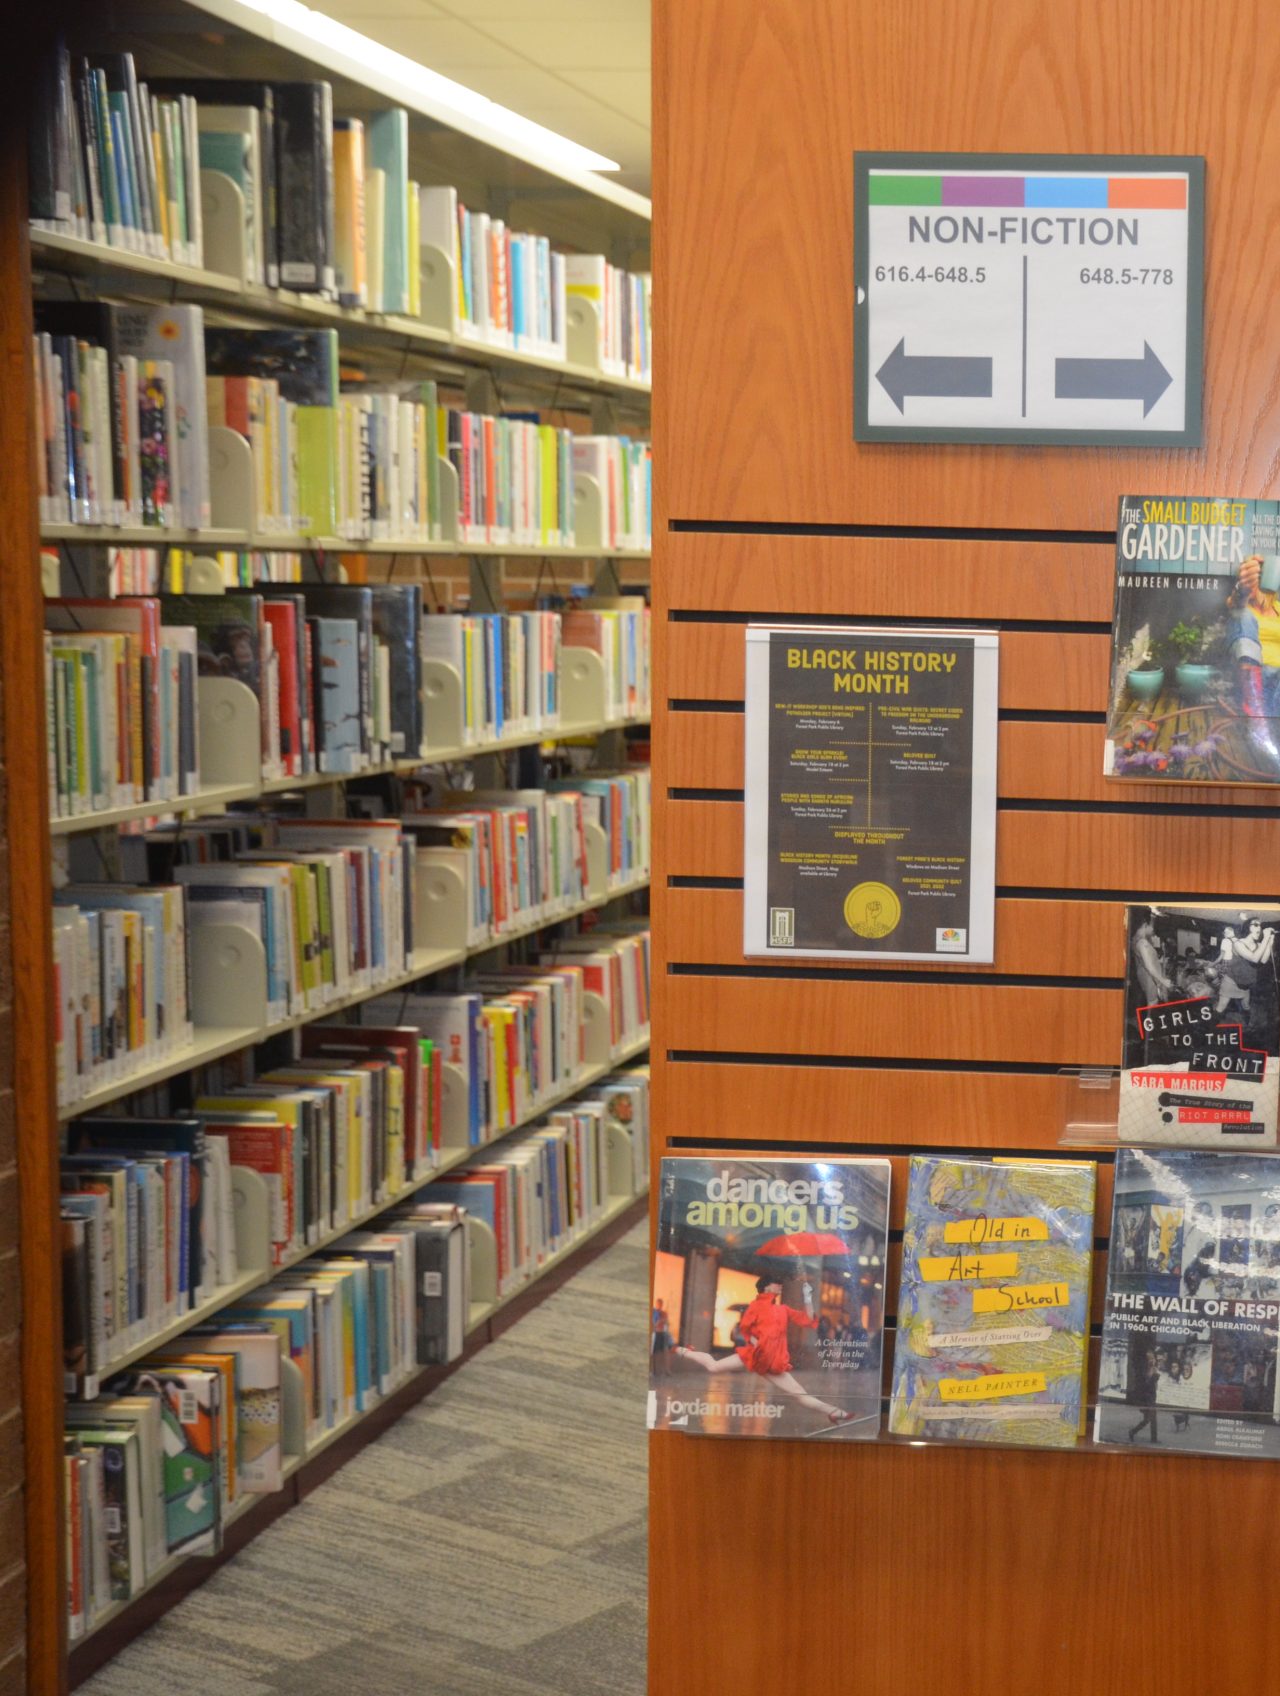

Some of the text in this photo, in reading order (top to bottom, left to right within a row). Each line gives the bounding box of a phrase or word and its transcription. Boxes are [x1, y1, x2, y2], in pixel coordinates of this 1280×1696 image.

[908, 216, 1138, 245] NON-FICTION
[875, 266, 986, 283] 616.4-648.5
[1079, 268, 1173, 285] 648.5-778
[1124, 501, 1247, 526] THE SMALL BUDGET
[1252, 514, 1263, 524] ALL
[1263, 515, 1275, 524] THE
[1252, 526, 1275, 536] SAVING
[1122, 523, 1244, 563] GARDENER
[1262, 538, 1276, 548] YOUR
[1118, 576, 1219, 590] MAUREEN GILMER
[787, 648, 956, 672] BLACK HISTORY
[833, 673, 910, 694] MONTH
[1143, 1006, 1213, 1032] GIRLS
[1171, 1033, 1239, 1047] TO THE
[1192, 1052, 1263, 1074] FRONT
[1132, 1075, 1224, 1091] SARA MARCUS
[1179, 1107, 1249, 1120] RIOT GRRRL
[706, 1170, 844, 1205] dancers
[686, 1200, 859, 1235] among us
[970, 1212, 1031, 1248] Old in
[948, 1253, 984, 1281] Art
[997, 1282, 1060, 1314] School
[1112, 1292, 1144, 1309] THE
[1150, 1295, 1199, 1315] WALL
[1203, 1299, 1229, 1316] OF
[1110, 1313, 1260, 1332] PUBLIC ART AND BLACK LIBERATION
[1110, 1322, 1191, 1335] IN 1960s CHICAGO
[815, 1339, 869, 1348] A Celebration
[939, 1330, 1043, 1344] A Memoir of Starting Over
[818, 1349, 865, 1359] of Joy in the
[822, 1359, 860, 1369] Everyday
[948, 1378, 1038, 1394] NELL PAINTER
[665, 1397, 785, 1419] jordan matter
